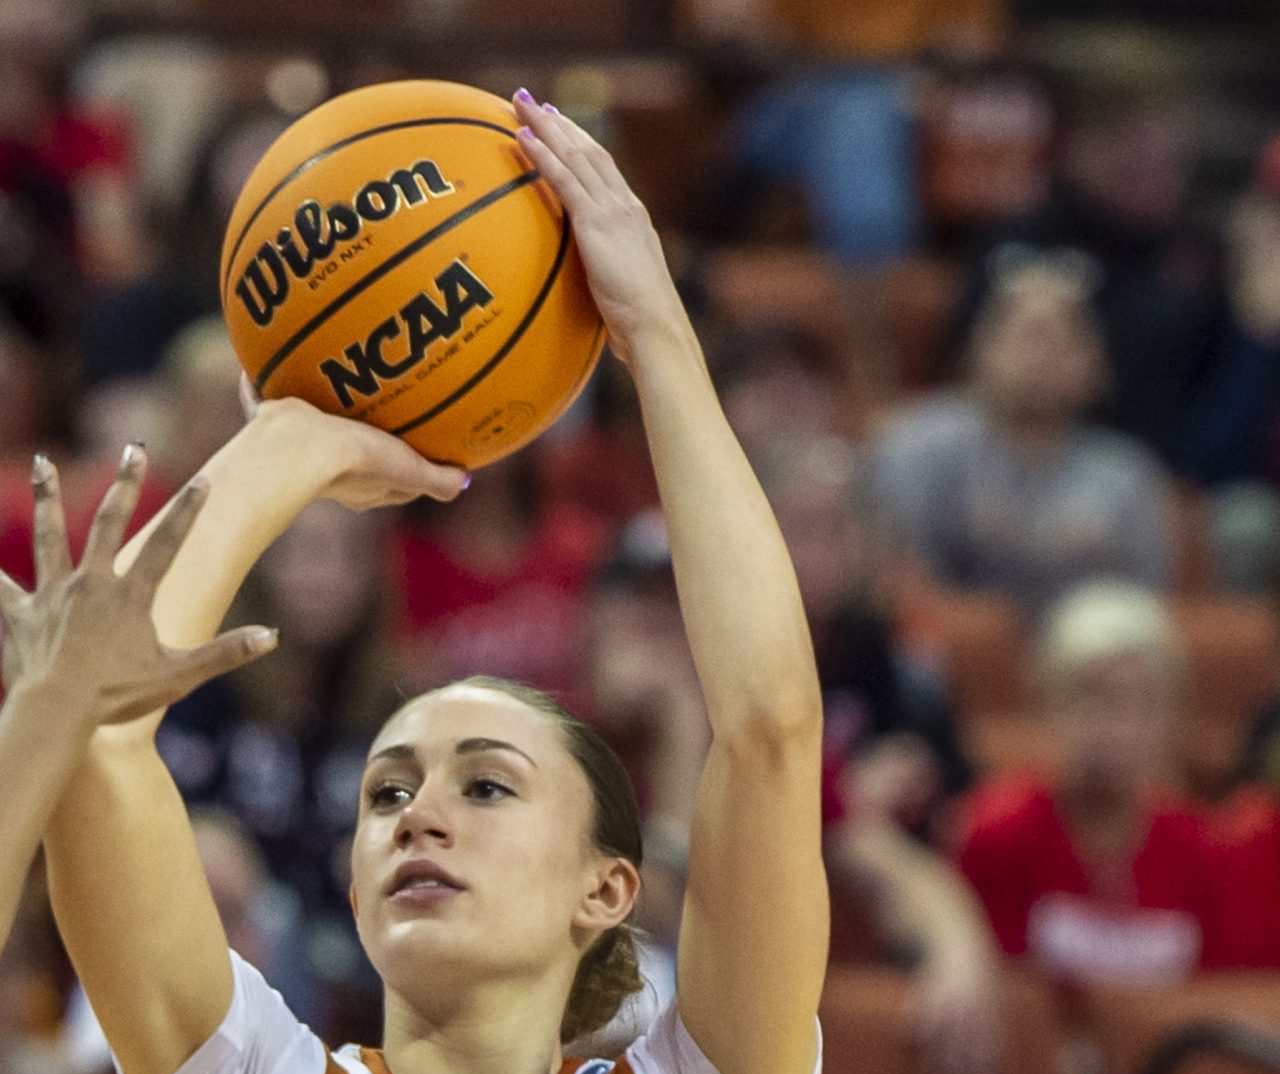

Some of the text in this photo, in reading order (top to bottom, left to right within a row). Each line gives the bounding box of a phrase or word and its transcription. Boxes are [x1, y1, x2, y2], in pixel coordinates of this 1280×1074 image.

[235, 158, 455, 327] Wilson
[308, 233, 373, 291] EVO NXT
[320, 258, 495, 408] NCAA
[463, 308, 503, 343] BALL
